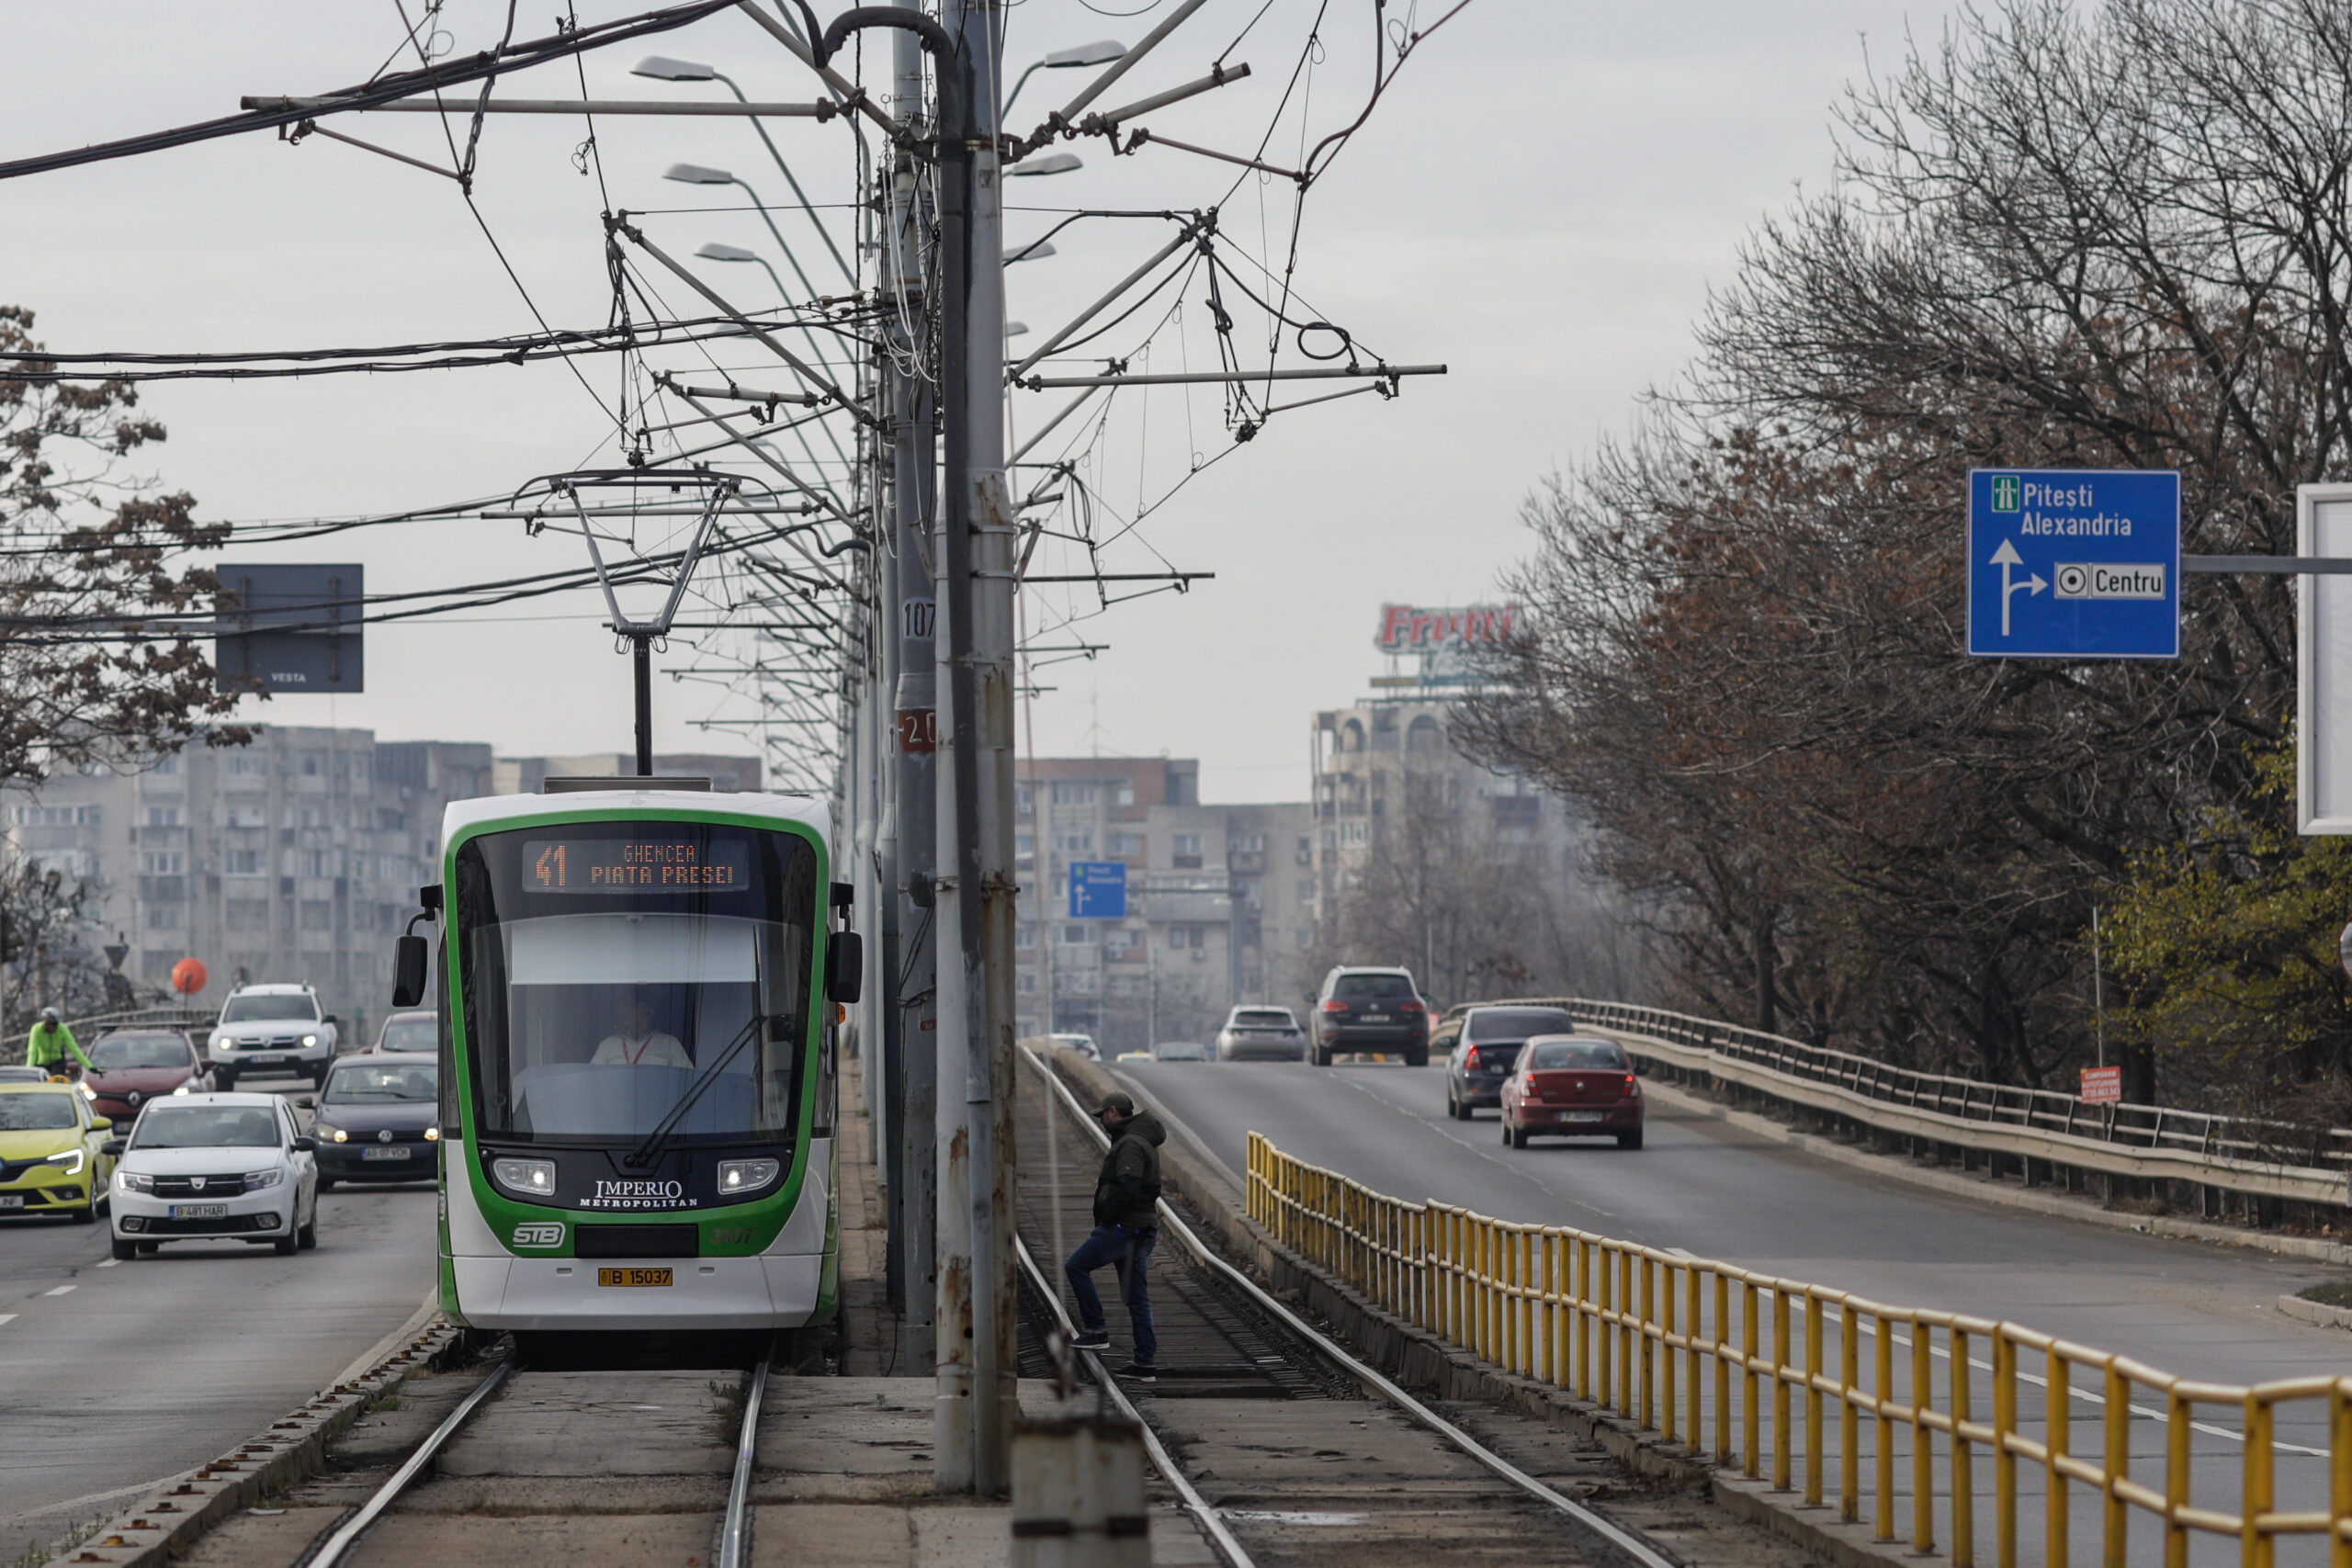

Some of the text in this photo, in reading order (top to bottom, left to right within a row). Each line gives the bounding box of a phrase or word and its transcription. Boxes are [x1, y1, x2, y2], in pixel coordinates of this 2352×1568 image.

[2021, 512, 2132, 536] Alexandria
[2096, 570, 2161, 592] Centru
[904, 602, 936, 637] 107
[1381, 605, 1516, 643] Frutti
[271, 672, 306, 682] VESTA
[624, 845, 695, 863] GHENCEA
[537, 845, 566, 886] 41
[591, 866, 733, 884] PIATA PRESEI
[595, 1180, 682, 1199] IMPERIO
[176, 1206, 184, 1216] B
[580, 1199, 697, 1207] METROPOLITAN
[513, 1227, 561, 1243] STB
[612, 1270, 671, 1284] B 15037
